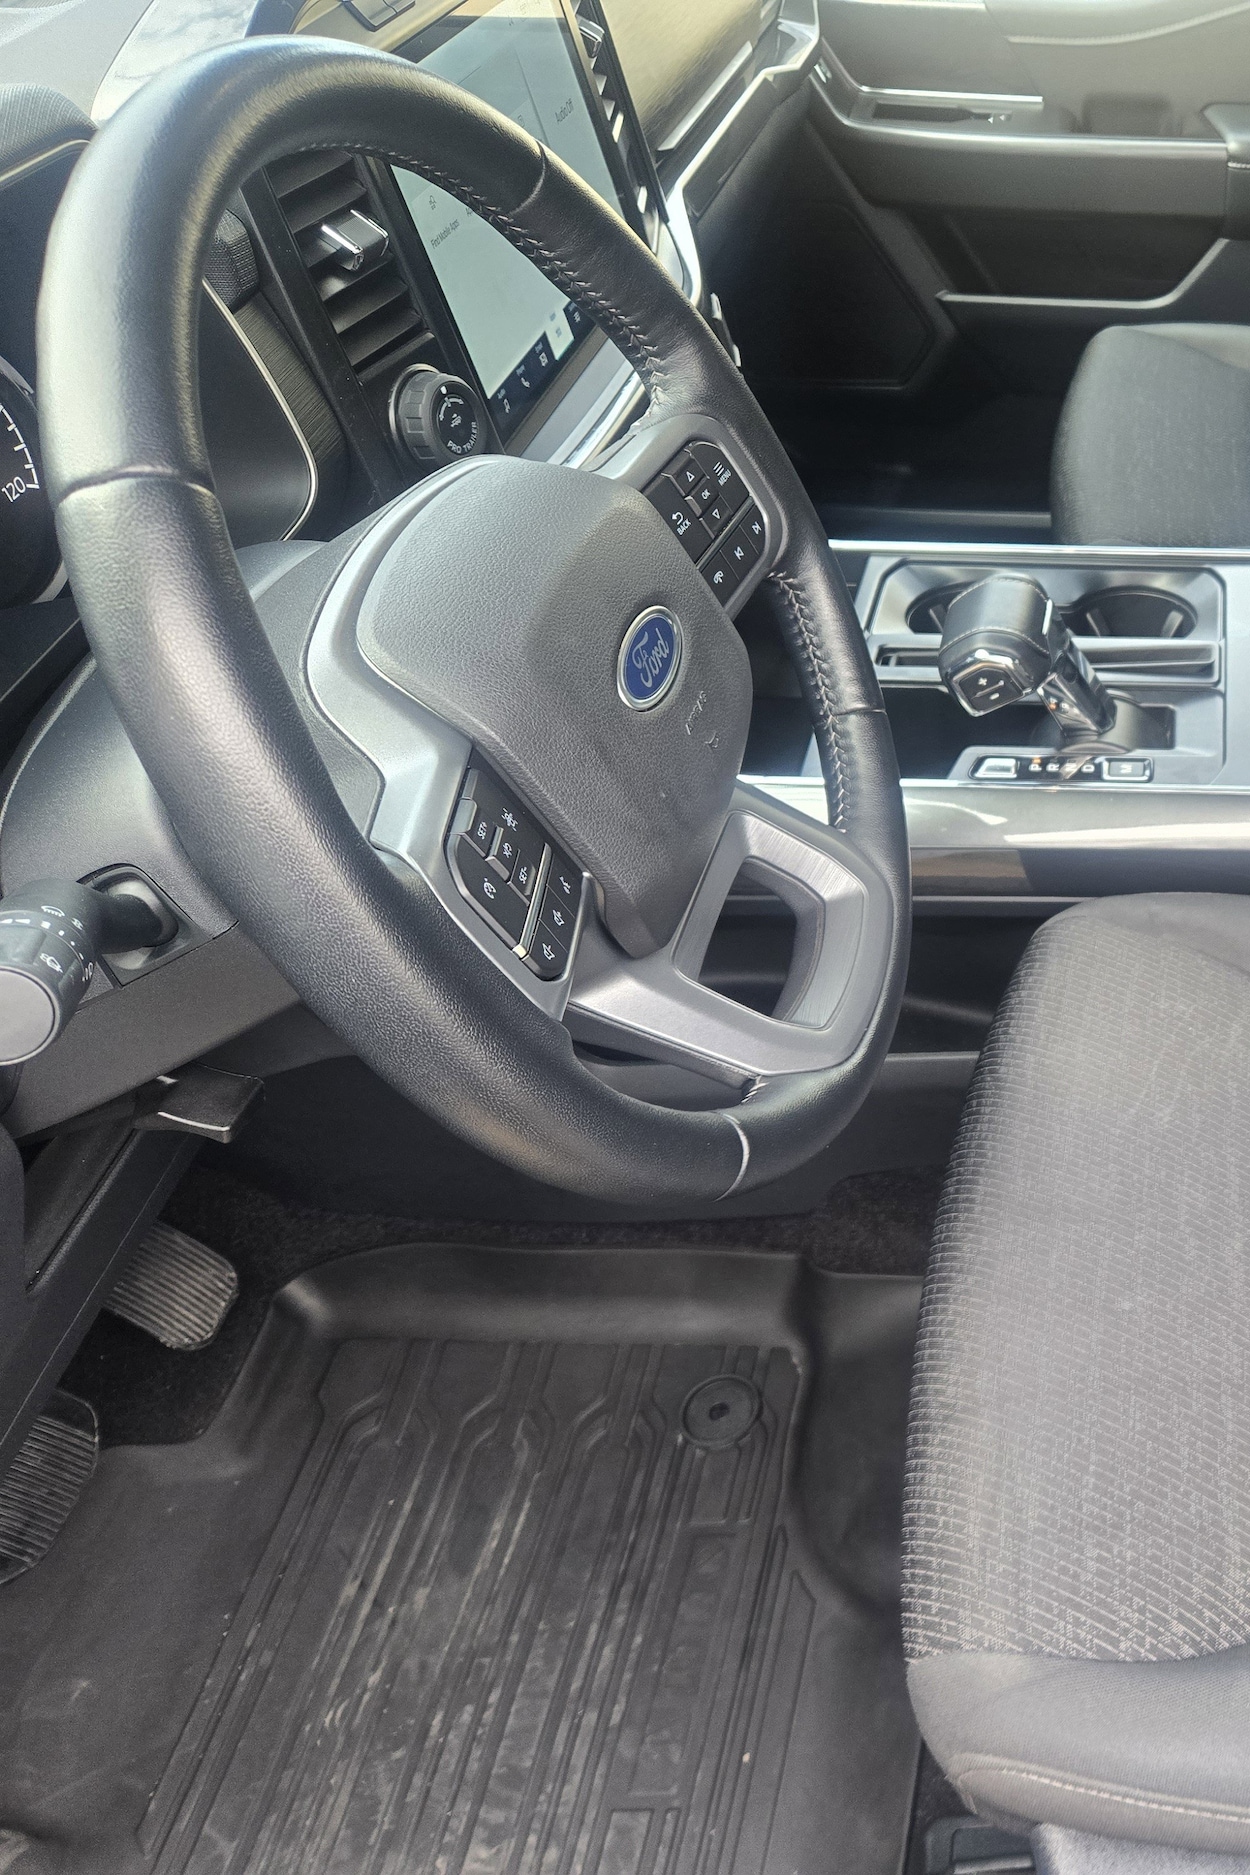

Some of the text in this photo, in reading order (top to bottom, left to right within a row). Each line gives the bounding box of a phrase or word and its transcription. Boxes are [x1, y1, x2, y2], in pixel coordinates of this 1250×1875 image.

[447, 421, 477, 453] PRO TRAILER
[718, 469, 732, 486] MENU
[1, 476, 26, 502] 120
[701, 488, 711, 500] OK
[676, 518, 692, 536] BACK
[632, 627, 670, 688] Ford
